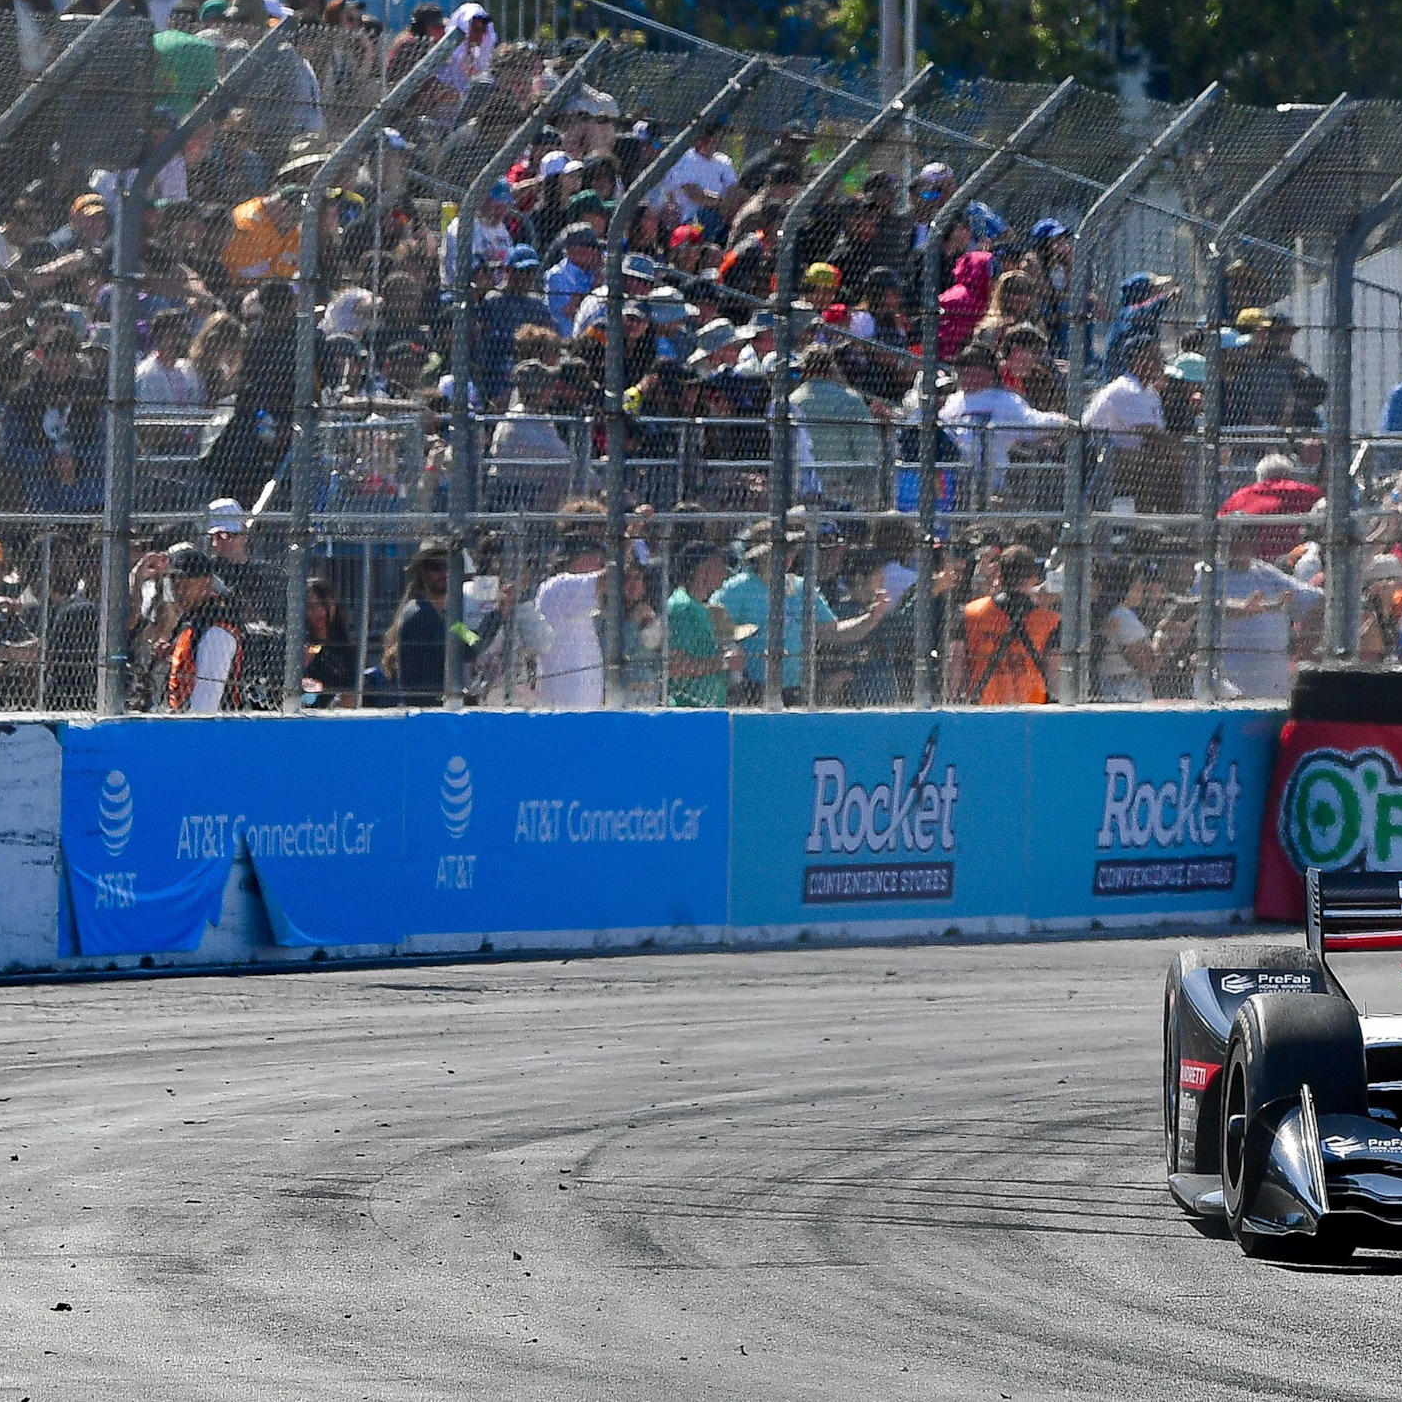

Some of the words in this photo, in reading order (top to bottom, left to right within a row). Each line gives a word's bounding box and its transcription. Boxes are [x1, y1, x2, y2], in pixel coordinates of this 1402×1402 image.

[514, 800, 564, 843] AT&T
[566, 799, 667, 842] Connected
[670, 799, 701, 841] Car
[805, 754, 959, 855] Rocket
[1097, 752, 1241, 851] Rocket
[177, 816, 229, 860] AT&T
[232, 811, 338, 859] Connected
[342, 811, 374, 855] Car
[94, 871, 137, 911] AT&T
[435, 854, 477, 891] AT&T
[1258, 973, 1311, 984] PreFab
